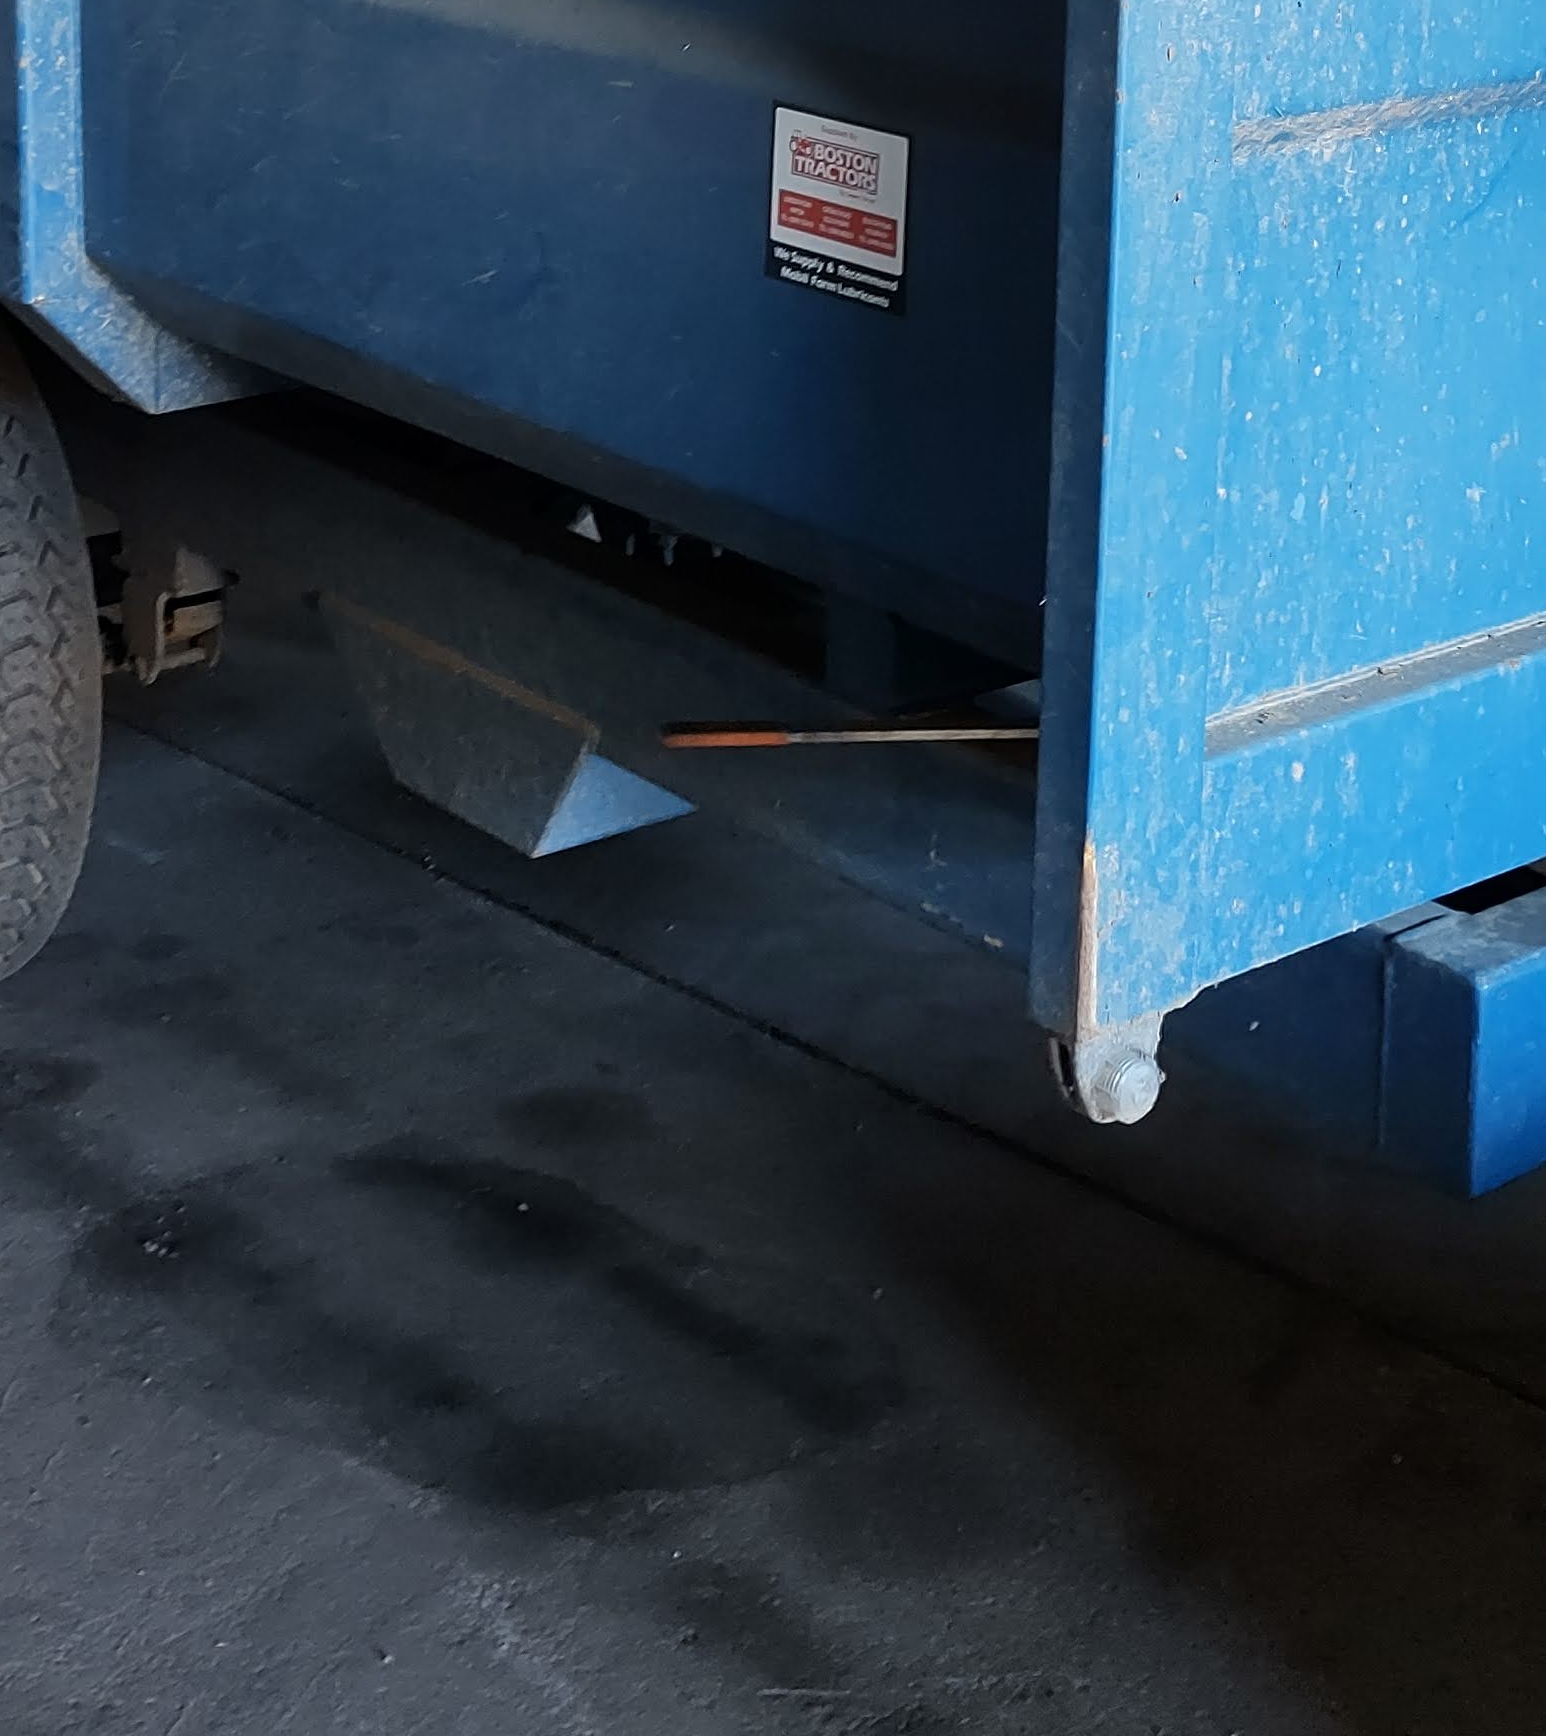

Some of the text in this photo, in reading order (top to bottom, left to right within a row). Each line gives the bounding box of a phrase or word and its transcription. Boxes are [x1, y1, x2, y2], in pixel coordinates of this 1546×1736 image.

[794, 155, 877, 191] TRACTORS
[813, 143, 878, 175] BOSTON
[790, 250, 825, 274] Supply
[825, 260, 835, 274] &
[837, 263, 899, 292] Recommend
[837, 282, 890, 308] Lubricants
